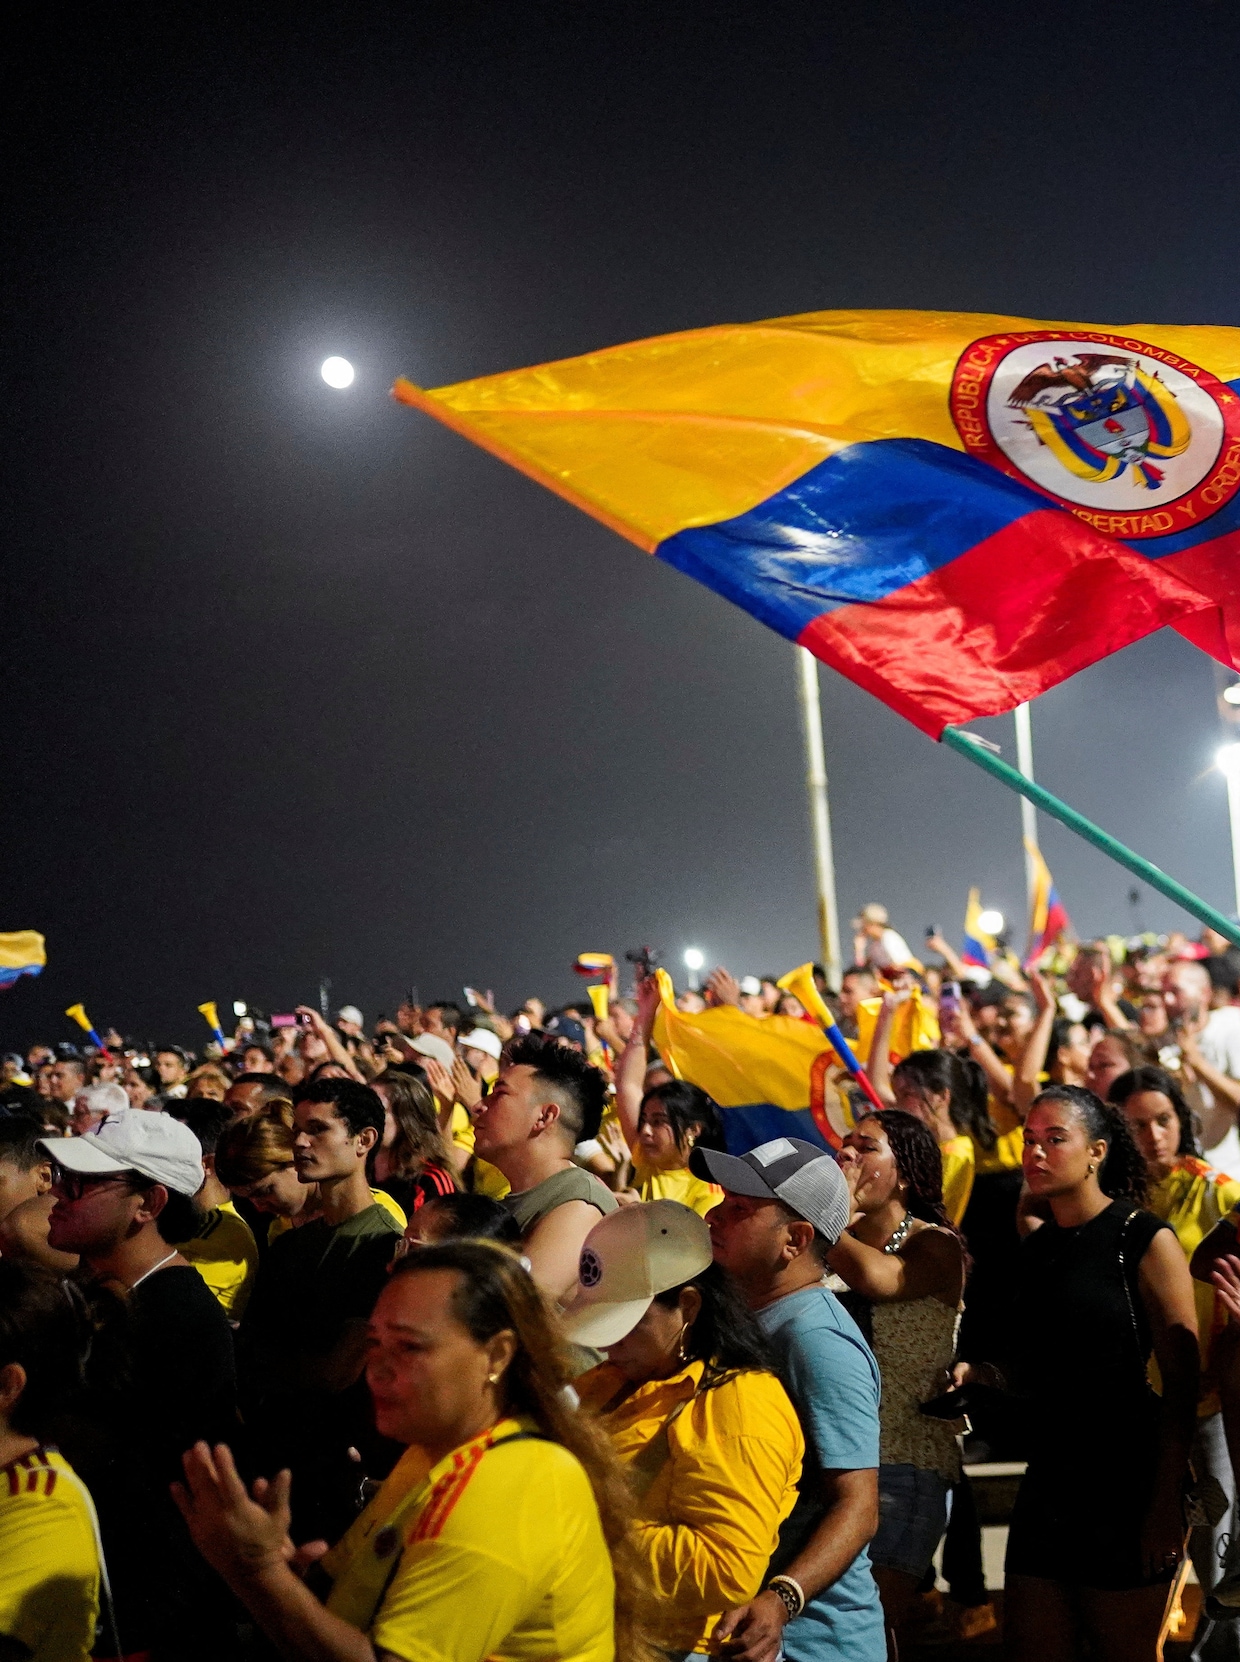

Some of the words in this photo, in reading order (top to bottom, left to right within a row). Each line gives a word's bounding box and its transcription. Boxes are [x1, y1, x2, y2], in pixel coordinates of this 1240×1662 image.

[957, 344, 1003, 447] REPUBLICA
[1069, 332, 1201, 378] COLOMBIA
[1176, 500, 1197, 519] Y
